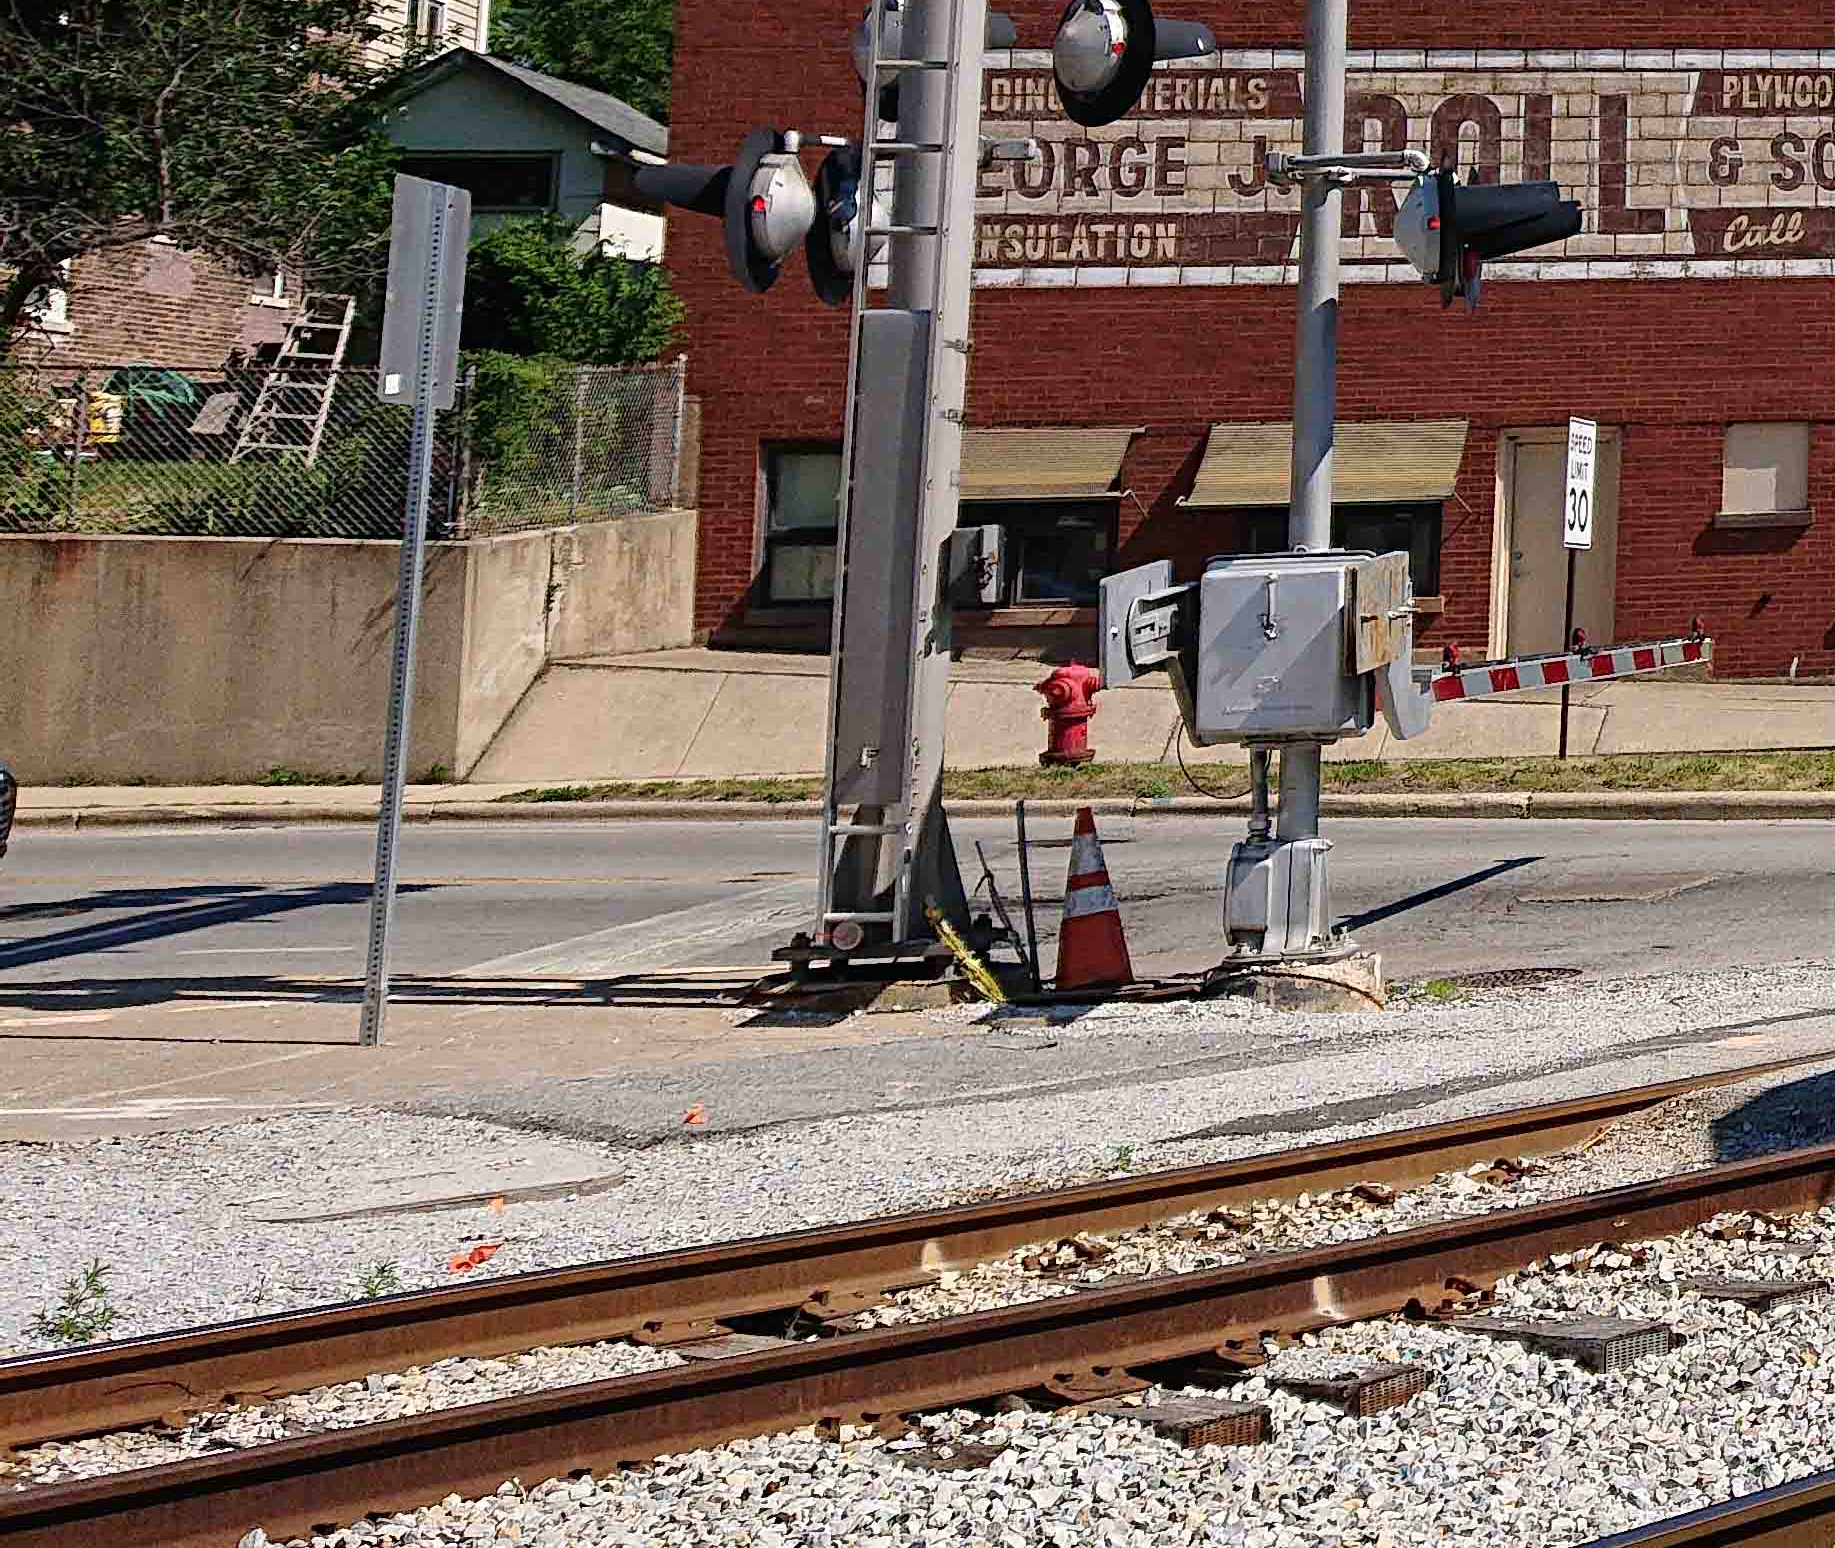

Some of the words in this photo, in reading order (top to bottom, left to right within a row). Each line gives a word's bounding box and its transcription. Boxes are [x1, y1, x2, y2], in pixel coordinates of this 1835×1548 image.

[1139, 77, 1267, 111] TERIALS
[976, 135, 1186, 198] EORGE
[1709, 136, 1743, 187] &
[977, 222, 1177, 260] NSULATION
[1723, 212, 1807, 252] Call
[1570, 432, 1593, 455] SPEED
[1570, 460, 1590, 482] LIMIT
[1567, 487, 1589, 533] 30
